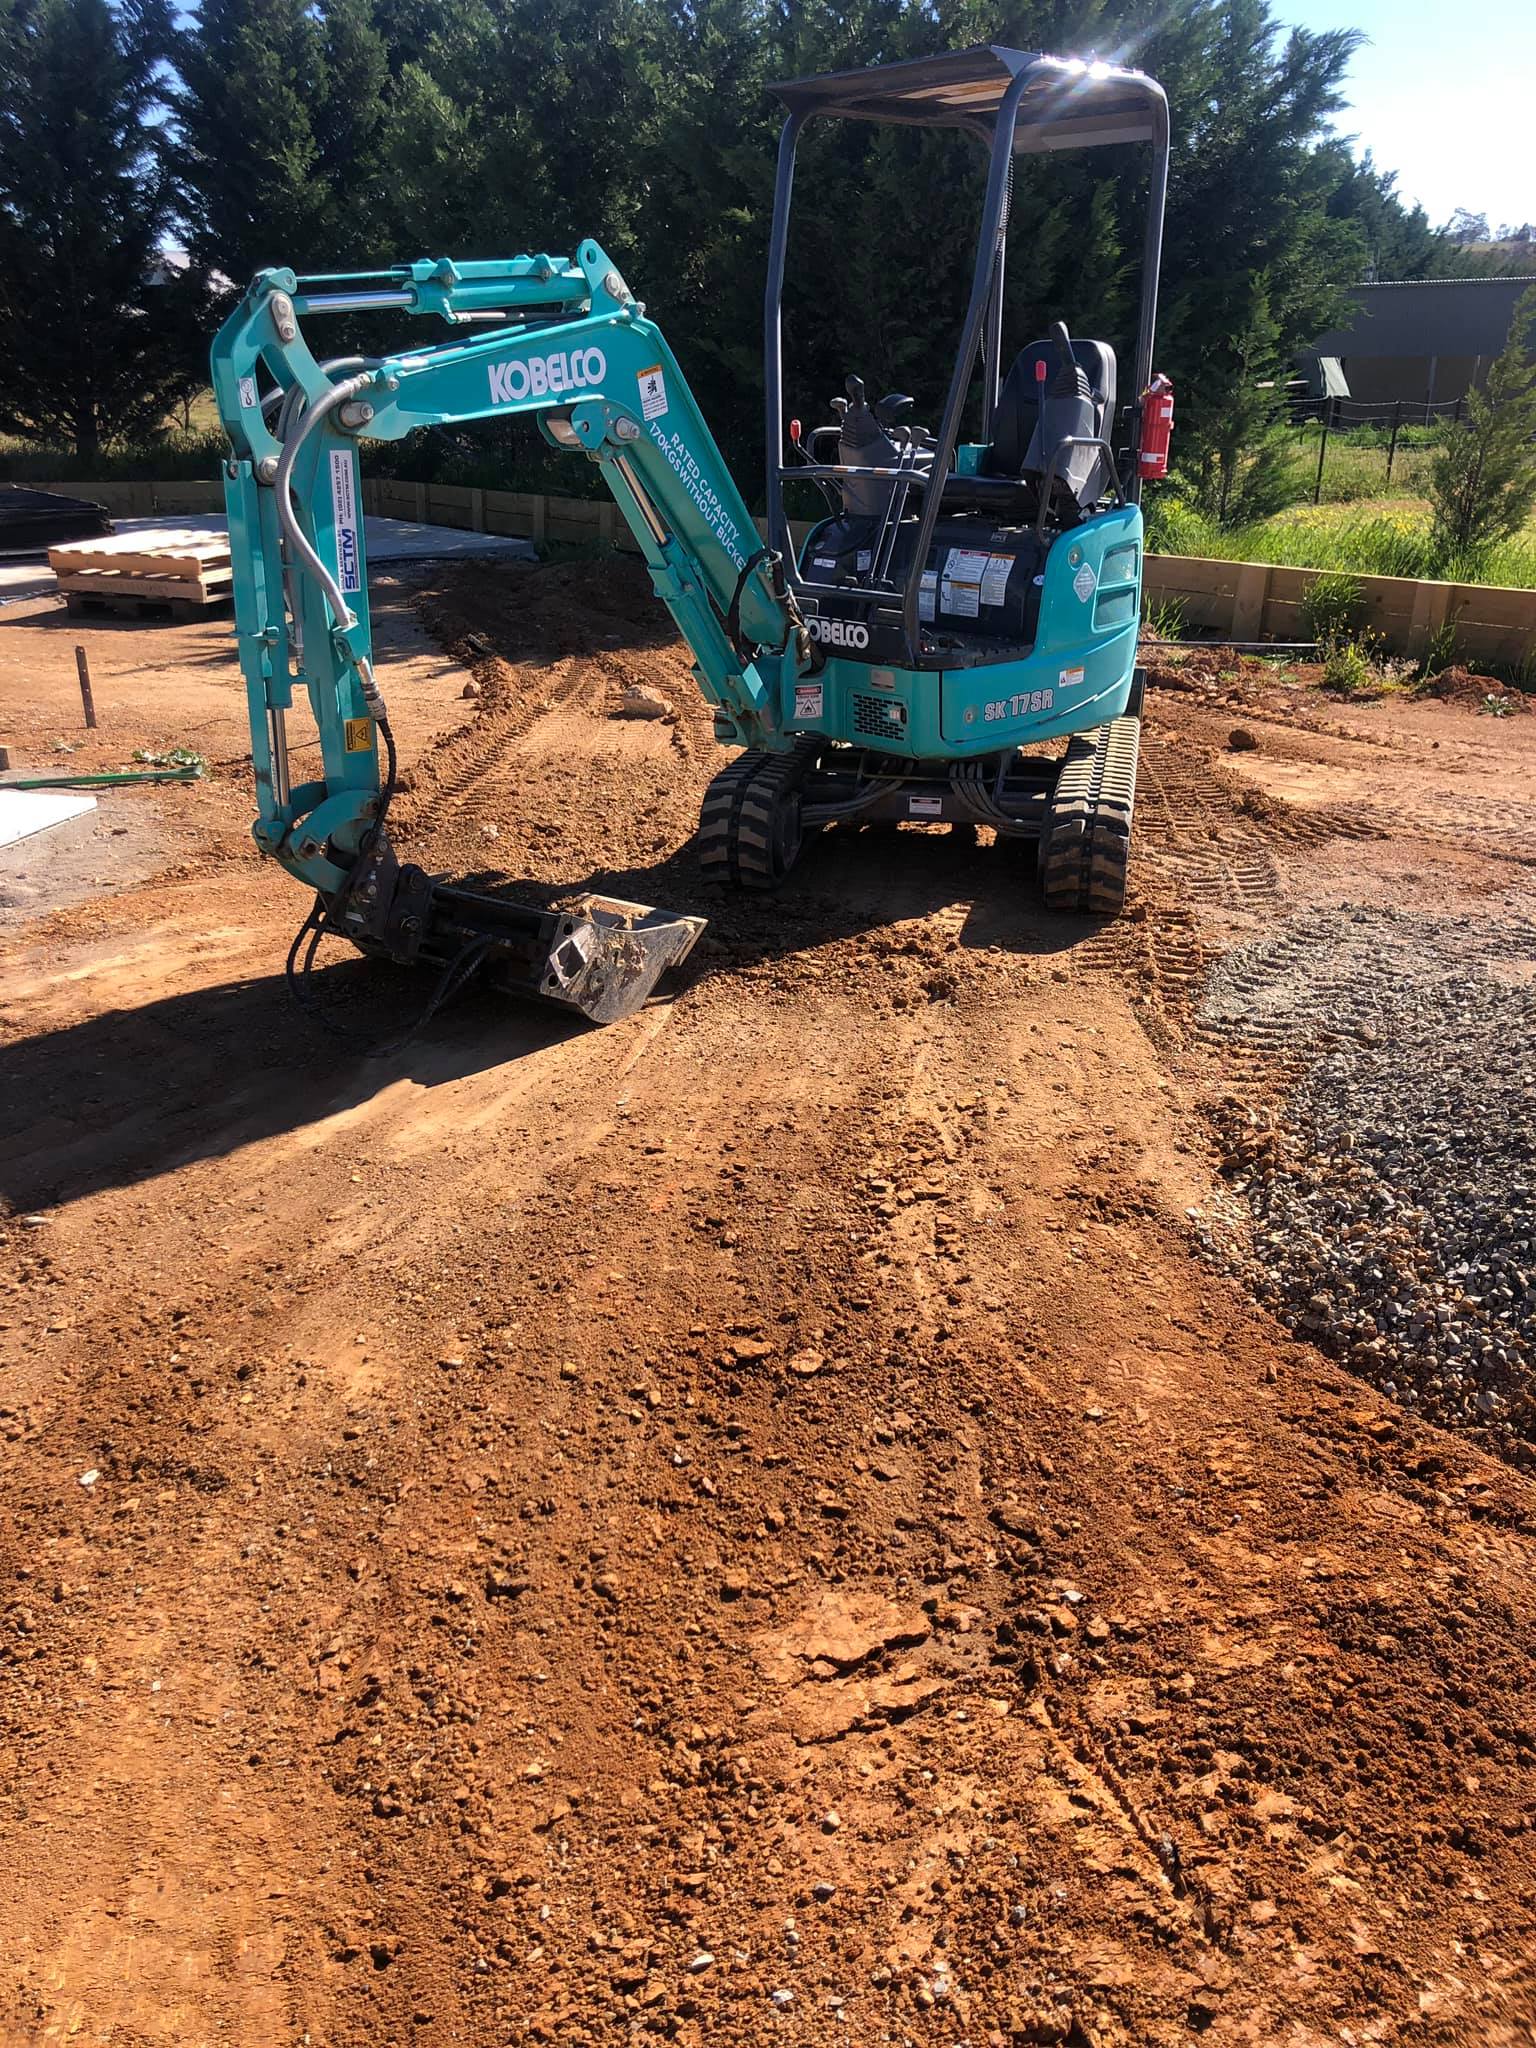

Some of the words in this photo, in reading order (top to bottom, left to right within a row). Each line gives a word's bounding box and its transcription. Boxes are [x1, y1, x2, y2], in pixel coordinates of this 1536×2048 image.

[487, 346, 607, 405] KOBELCO
[670, 432, 701, 479] RATED
[700, 479, 740, 541] CAPACITY
[341, 528, 356, 590] SCTM
[716, 527, 746, 572] BUCKE
[804, 618, 869, 649] OBELCO
[984, 701, 1007, 721] SK
[1010, 688, 1054, 716] 17SR
